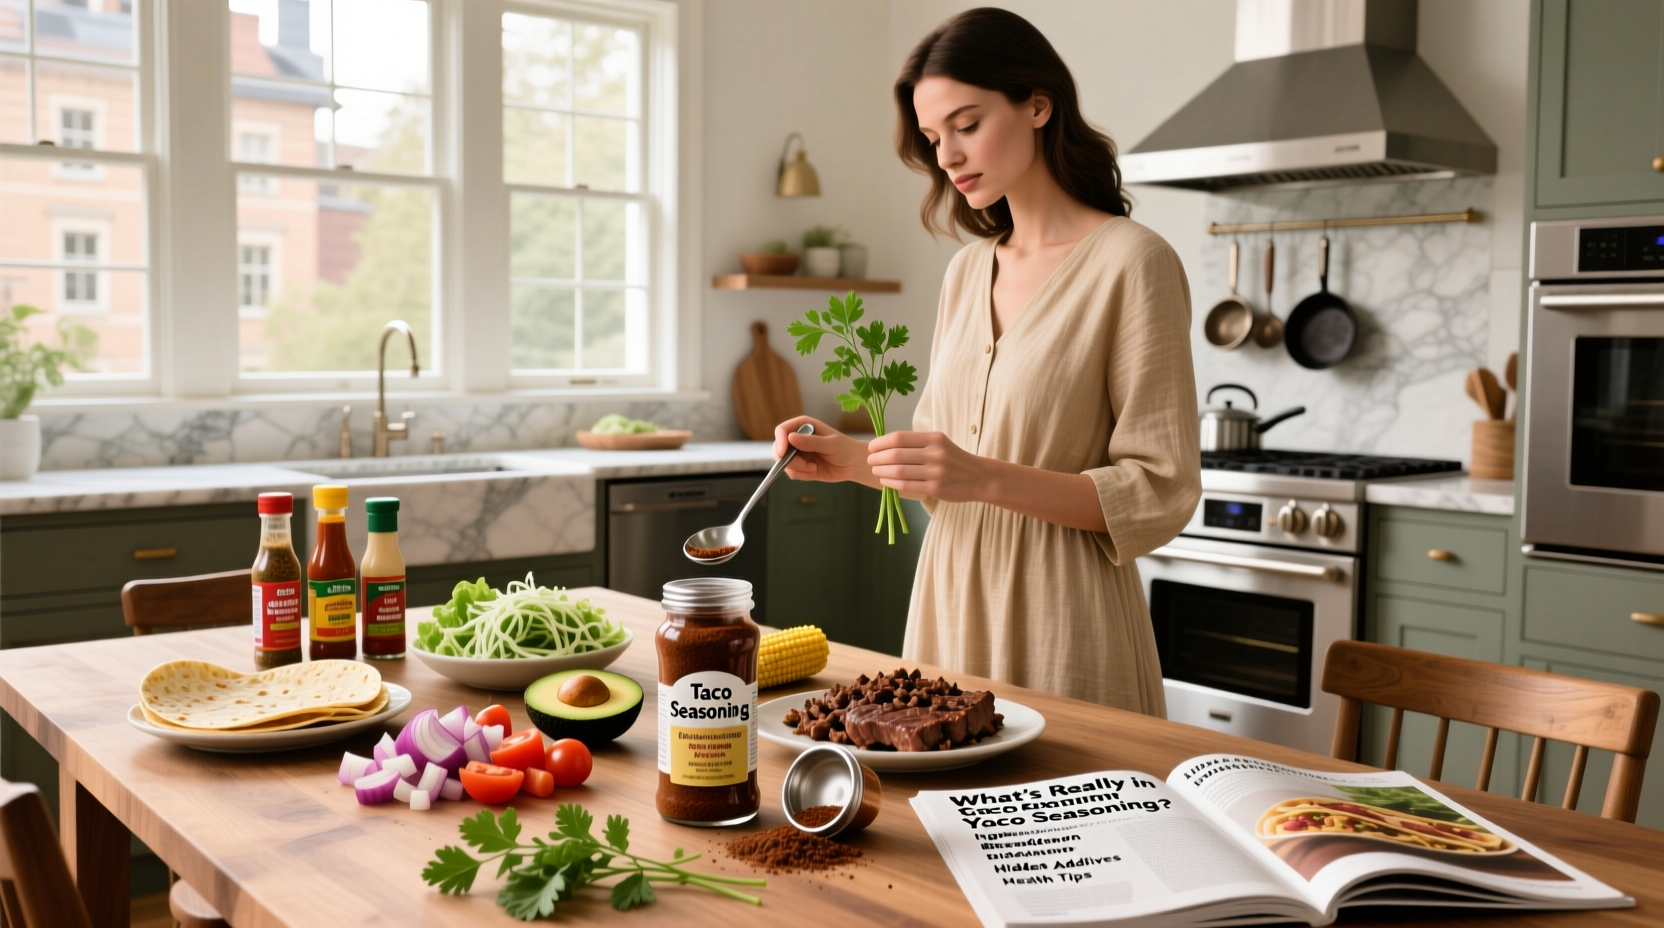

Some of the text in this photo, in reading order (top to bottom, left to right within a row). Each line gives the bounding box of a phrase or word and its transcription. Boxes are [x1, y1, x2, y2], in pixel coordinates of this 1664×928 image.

[690, 683, 732, 700] Taco
[670, 701, 749, 721] Seasoning
[949, 789, 1042, 807] What's
[1049, 777, 1124, 797] Really
[1131, 777, 1156, 791] in
[1032, 799, 1171, 823] Seasoning?
[1057, 872, 1092, 883] Tips
